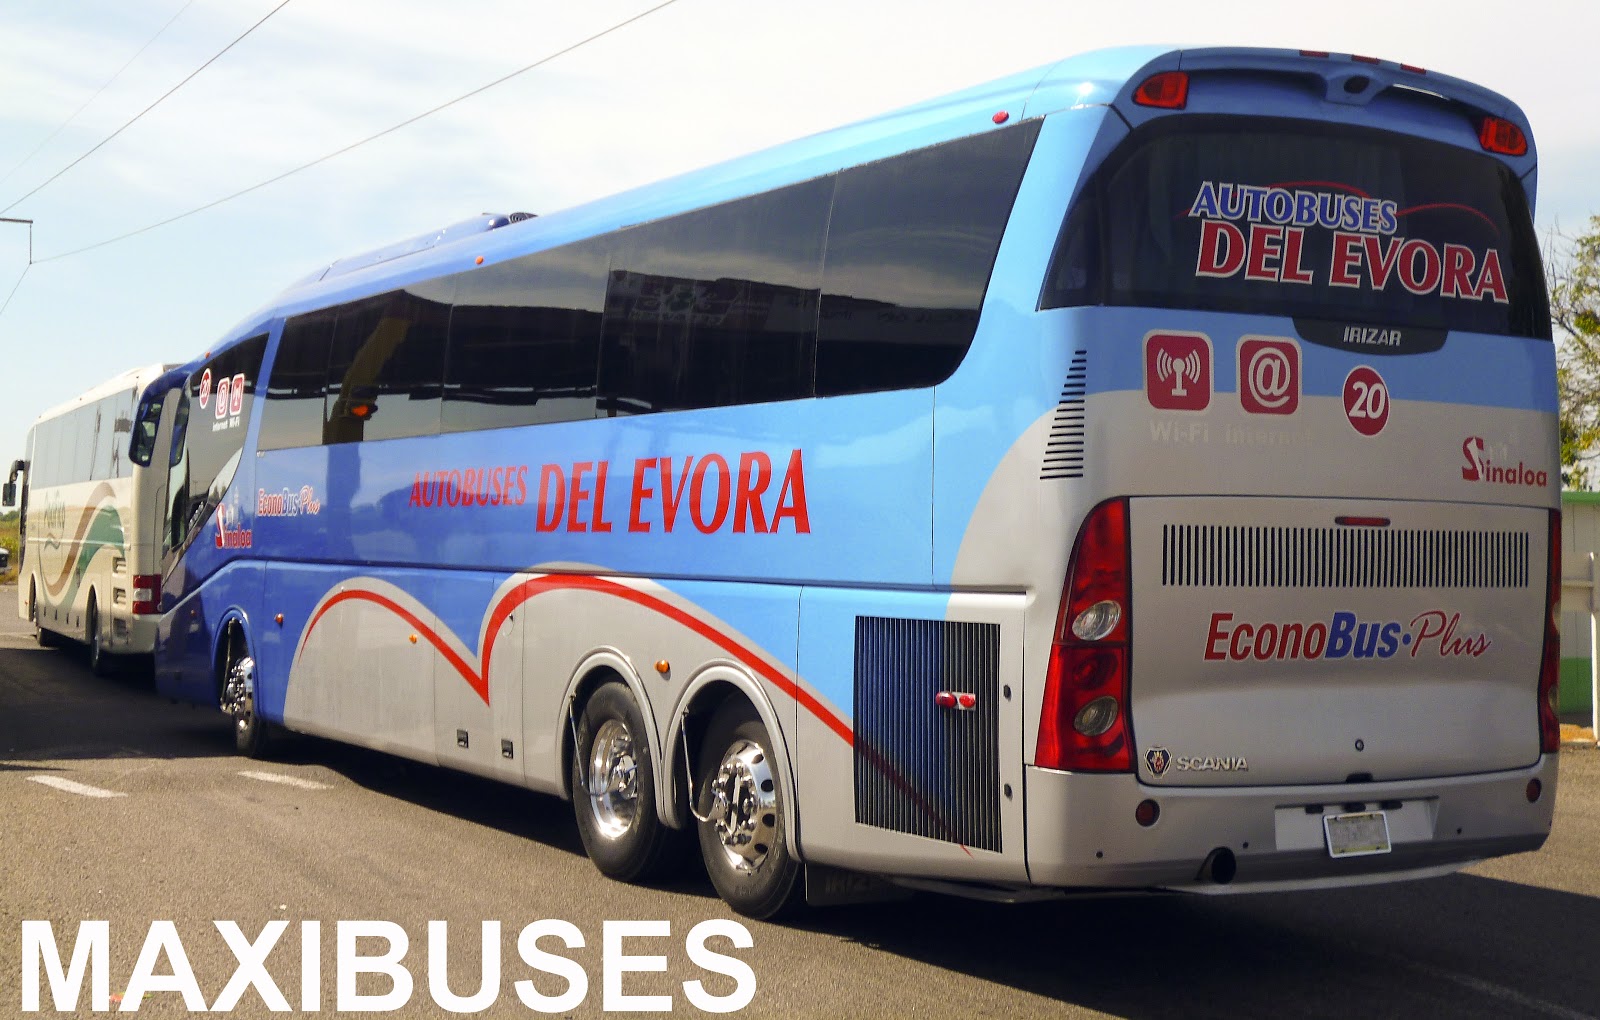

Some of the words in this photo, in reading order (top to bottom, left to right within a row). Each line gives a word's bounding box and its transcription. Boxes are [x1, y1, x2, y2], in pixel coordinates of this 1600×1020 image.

[1188, 181, 1398, 234] AUTOBUSES
[1195, 219, 1313, 285] DEL
[1328, 231, 1510, 305] EVORA
[1342, 326, 1402, 347] IRIZAR
[1349, 381, 1387, 420] 20
[1462, 436, 1548, 488] Sinaloa
[409, 465, 529, 508] AUTOBUSES
[535, 460, 613, 533] DEL
[628, 448, 811, 534] EVORA
[215, 503, 252, 549] Sinaloa
[1175, 755, 1249, 772] SCANIA
